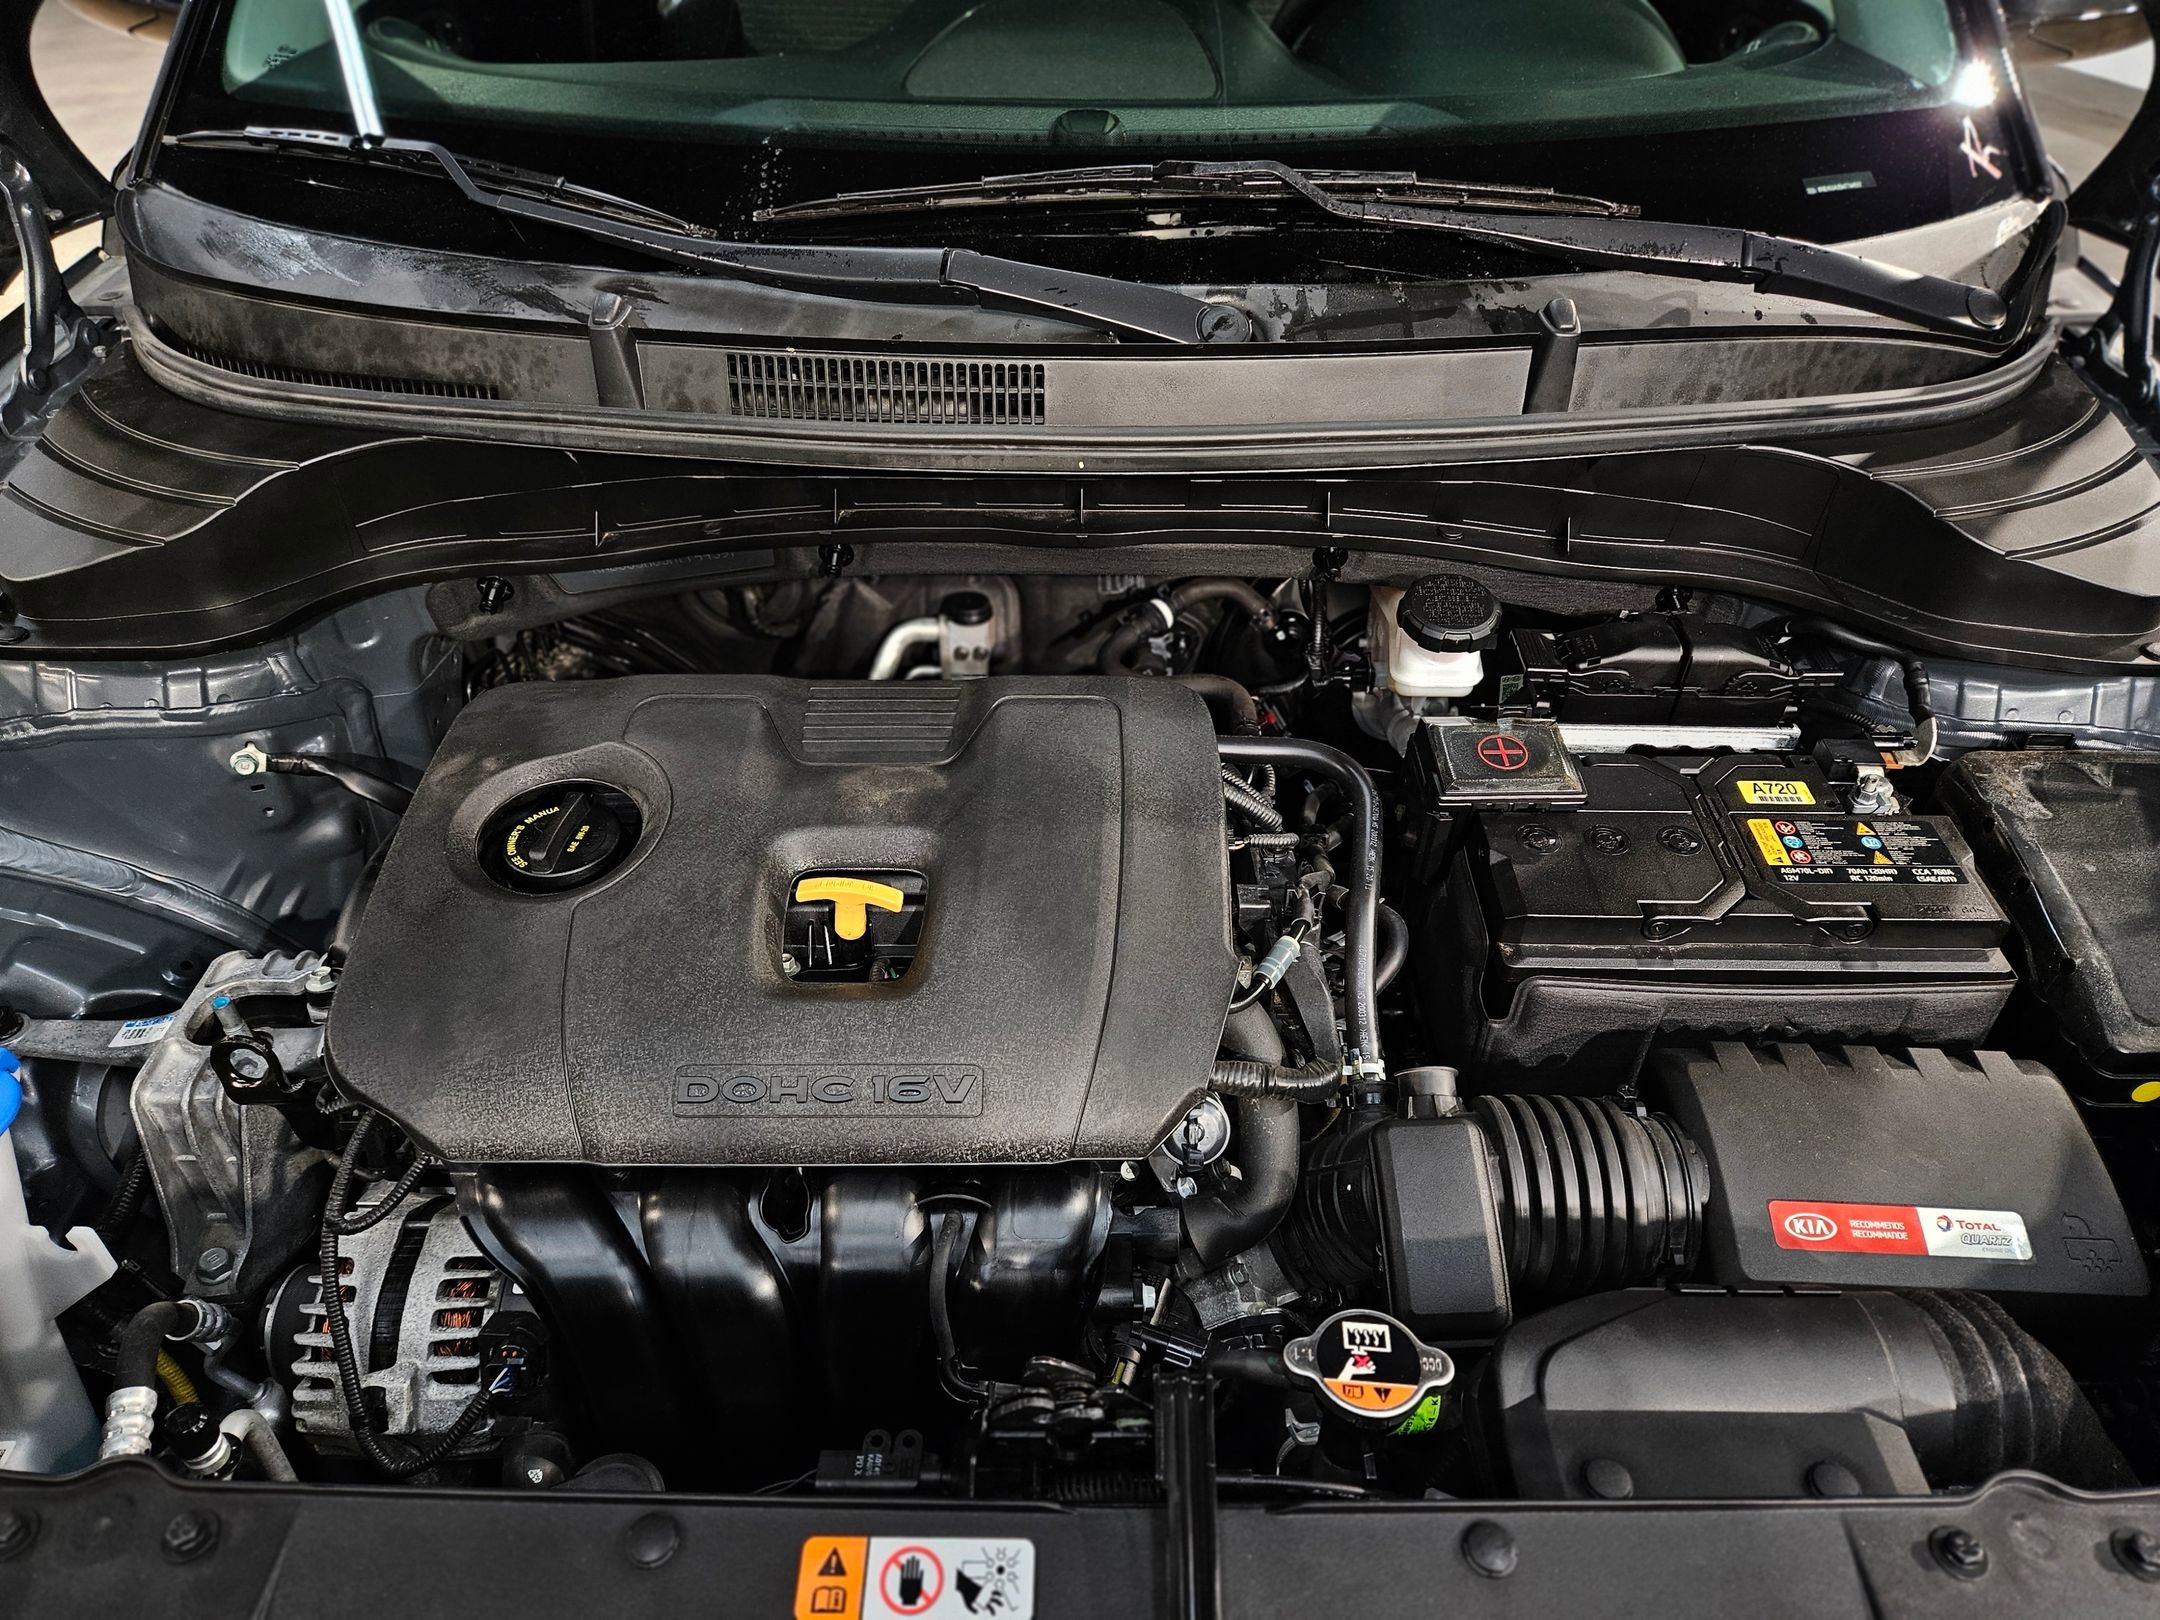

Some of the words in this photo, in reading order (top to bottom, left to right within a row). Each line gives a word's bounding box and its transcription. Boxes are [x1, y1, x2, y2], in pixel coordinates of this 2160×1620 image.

[1753, 782, 1798, 795] A720
[524, 806, 560, 824] MANUA
[506, 825, 526, 856] OWNER'S
[566, 841, 580, 853] SAE
[511, 855, 528, 868] SEE
[1846, 867, 1868, 875] 70Ah
[1357, 1002, 1367, 1025] 200312
[677, 1075, 855, 1104] DOHC
[871, 1074, 977, 1104] 16V
[1793, 1217, 1826, 1235] KIA
[1849, 1219, 1906, 1231] RECOMMENDS
[1956, 1220, 2002, 1232] TOTAL
[1852, 1229, 1909, 1241] RECOMMANDE
[1961, 1232, 2013, 1247] QUARTZ
